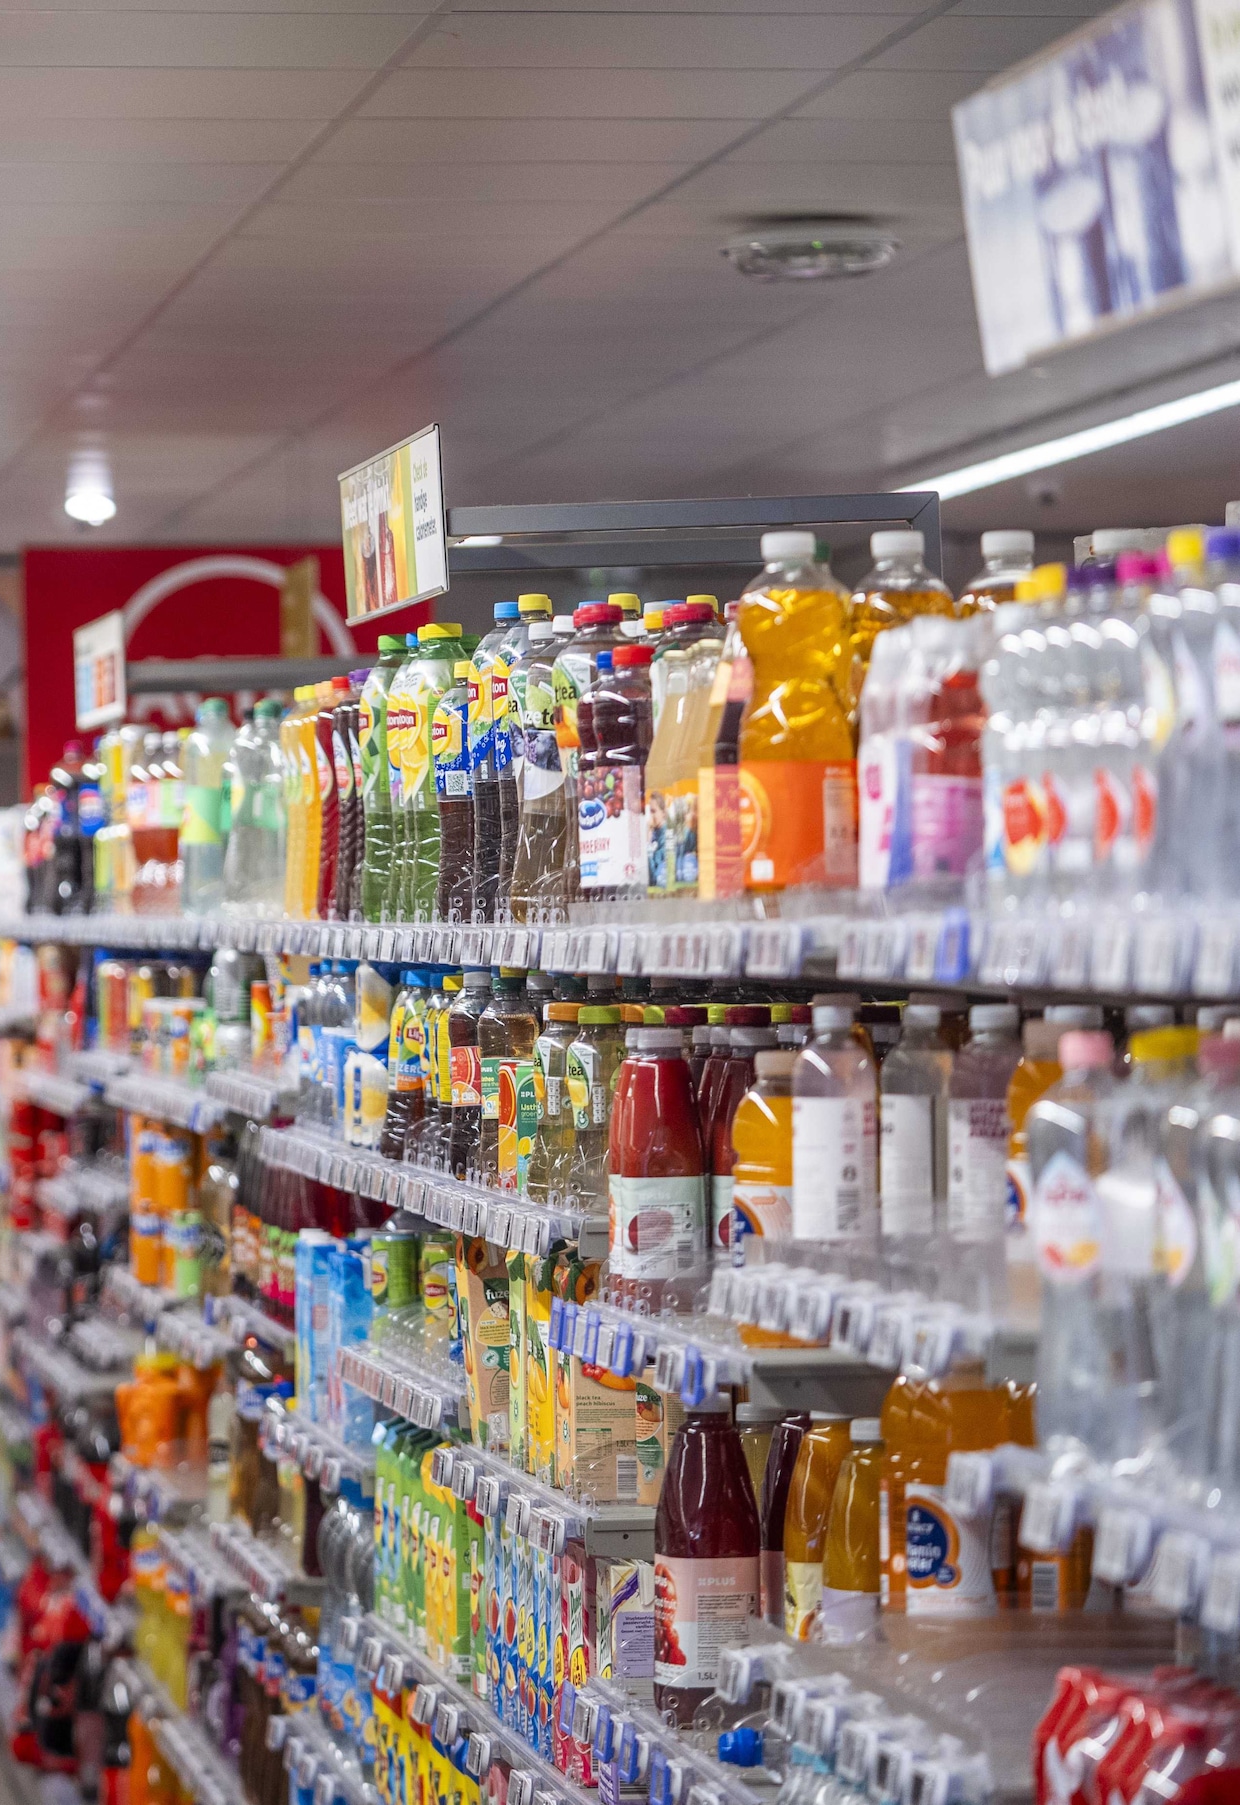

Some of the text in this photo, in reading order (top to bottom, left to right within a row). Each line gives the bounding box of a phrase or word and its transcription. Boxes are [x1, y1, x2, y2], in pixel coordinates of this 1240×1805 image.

[492, 682, 506, 694] ton
[432, 726, 445, 736] ton
[569, 1065, 584, 1076] tea
[486, 1289, 509, 1300] fuze
[707, 1577, 736, 1586] PLUS
